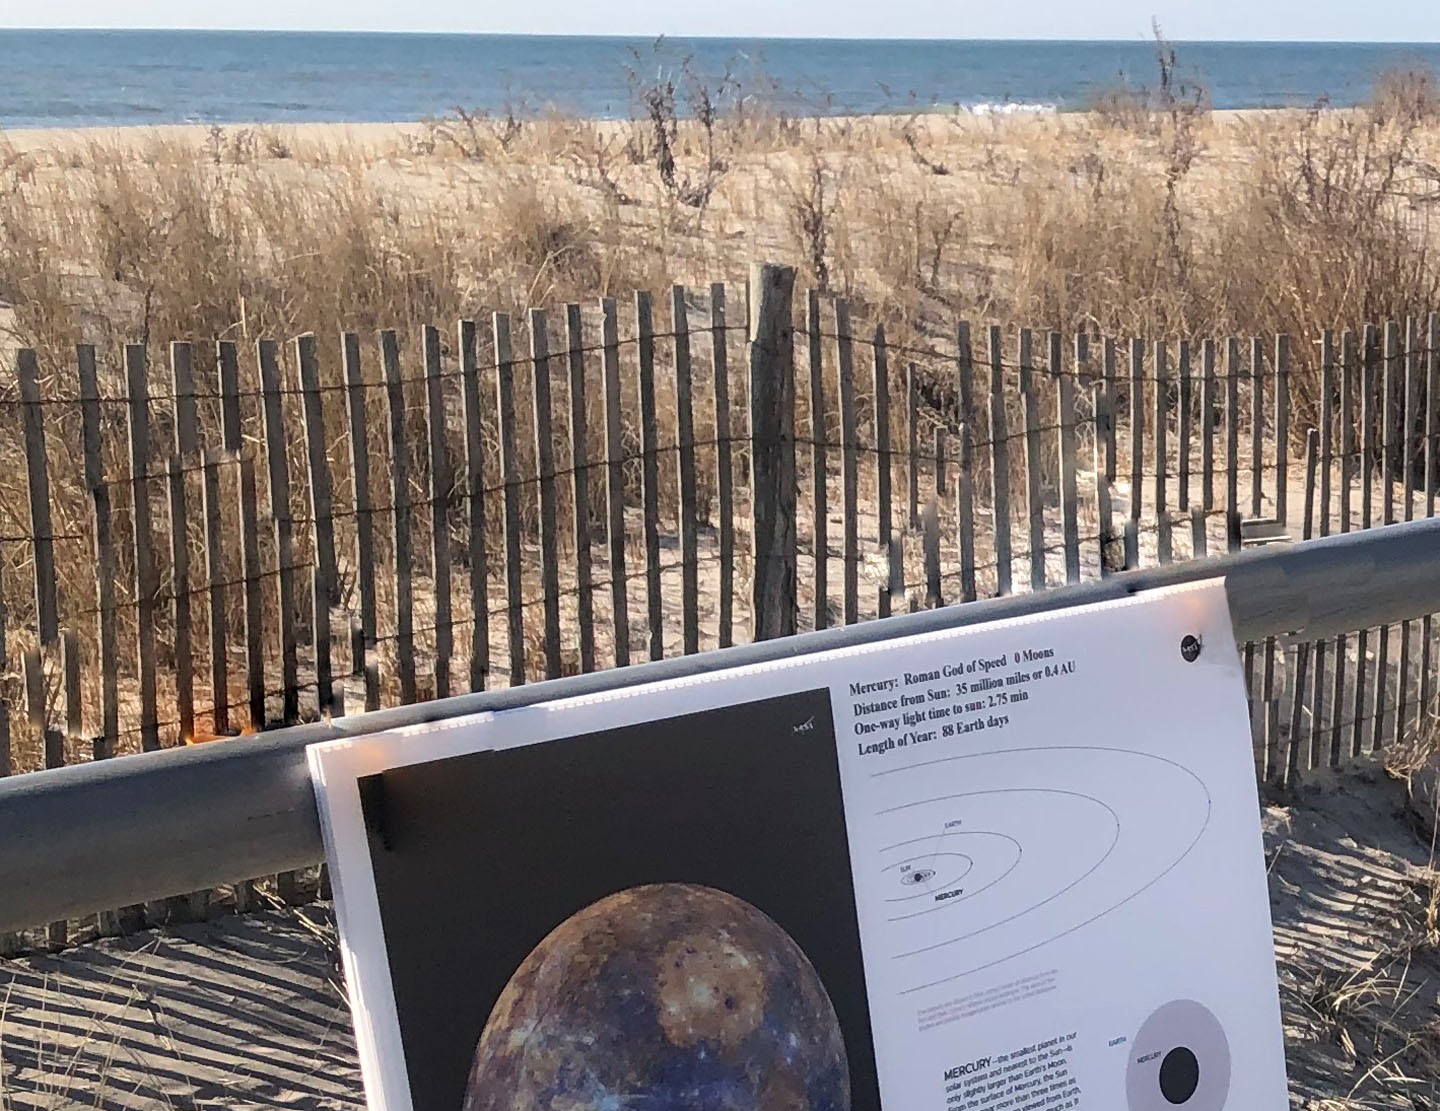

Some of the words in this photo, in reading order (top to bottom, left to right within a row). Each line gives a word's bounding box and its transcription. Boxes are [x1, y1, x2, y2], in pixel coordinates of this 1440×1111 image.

[849, 678, 898, 695] Mercury:
[904, 670, 940, 685] Roman
[942, 662, 964, 677] God
[966, 660, 976, 672] of
[978, 654, 1007, 672] Speed
[1014, 652, 1021, 663] 0
[1022, 648, 1054, 661] Moons
[853, 700, 898, 716] Distance
[900, 694, 925, 706] from
[927, 689, 951, 701] Sun:
[956, 682, 968, 695] 35
[970, 677, 1004, 692] million
[1005, 671, 1031, 685] miles
[1032, 670, 1043, 679] or
[1045, 664, 1059, 677] 0.4
[1060, 661, 1075, 674] AU
[854, 718, 900, 734] One-way
[902, 711, 926, 726] light
[928, 707, 951, 719] time
[952, 704, 963, 714] to
[965, 700, 986, 711] sun:
[988, 692, 1008, 707] 2.75
[1010, 689, 1029, 702] min
[858, 737, 895, 755] Length
[897, 733, 908, 746] of
[909, 731, 937, 743] Year:
[942, 724, 954, 736] 88
[956, 718, 985, 734] Earth
[987, 715, 1009, 728] days
